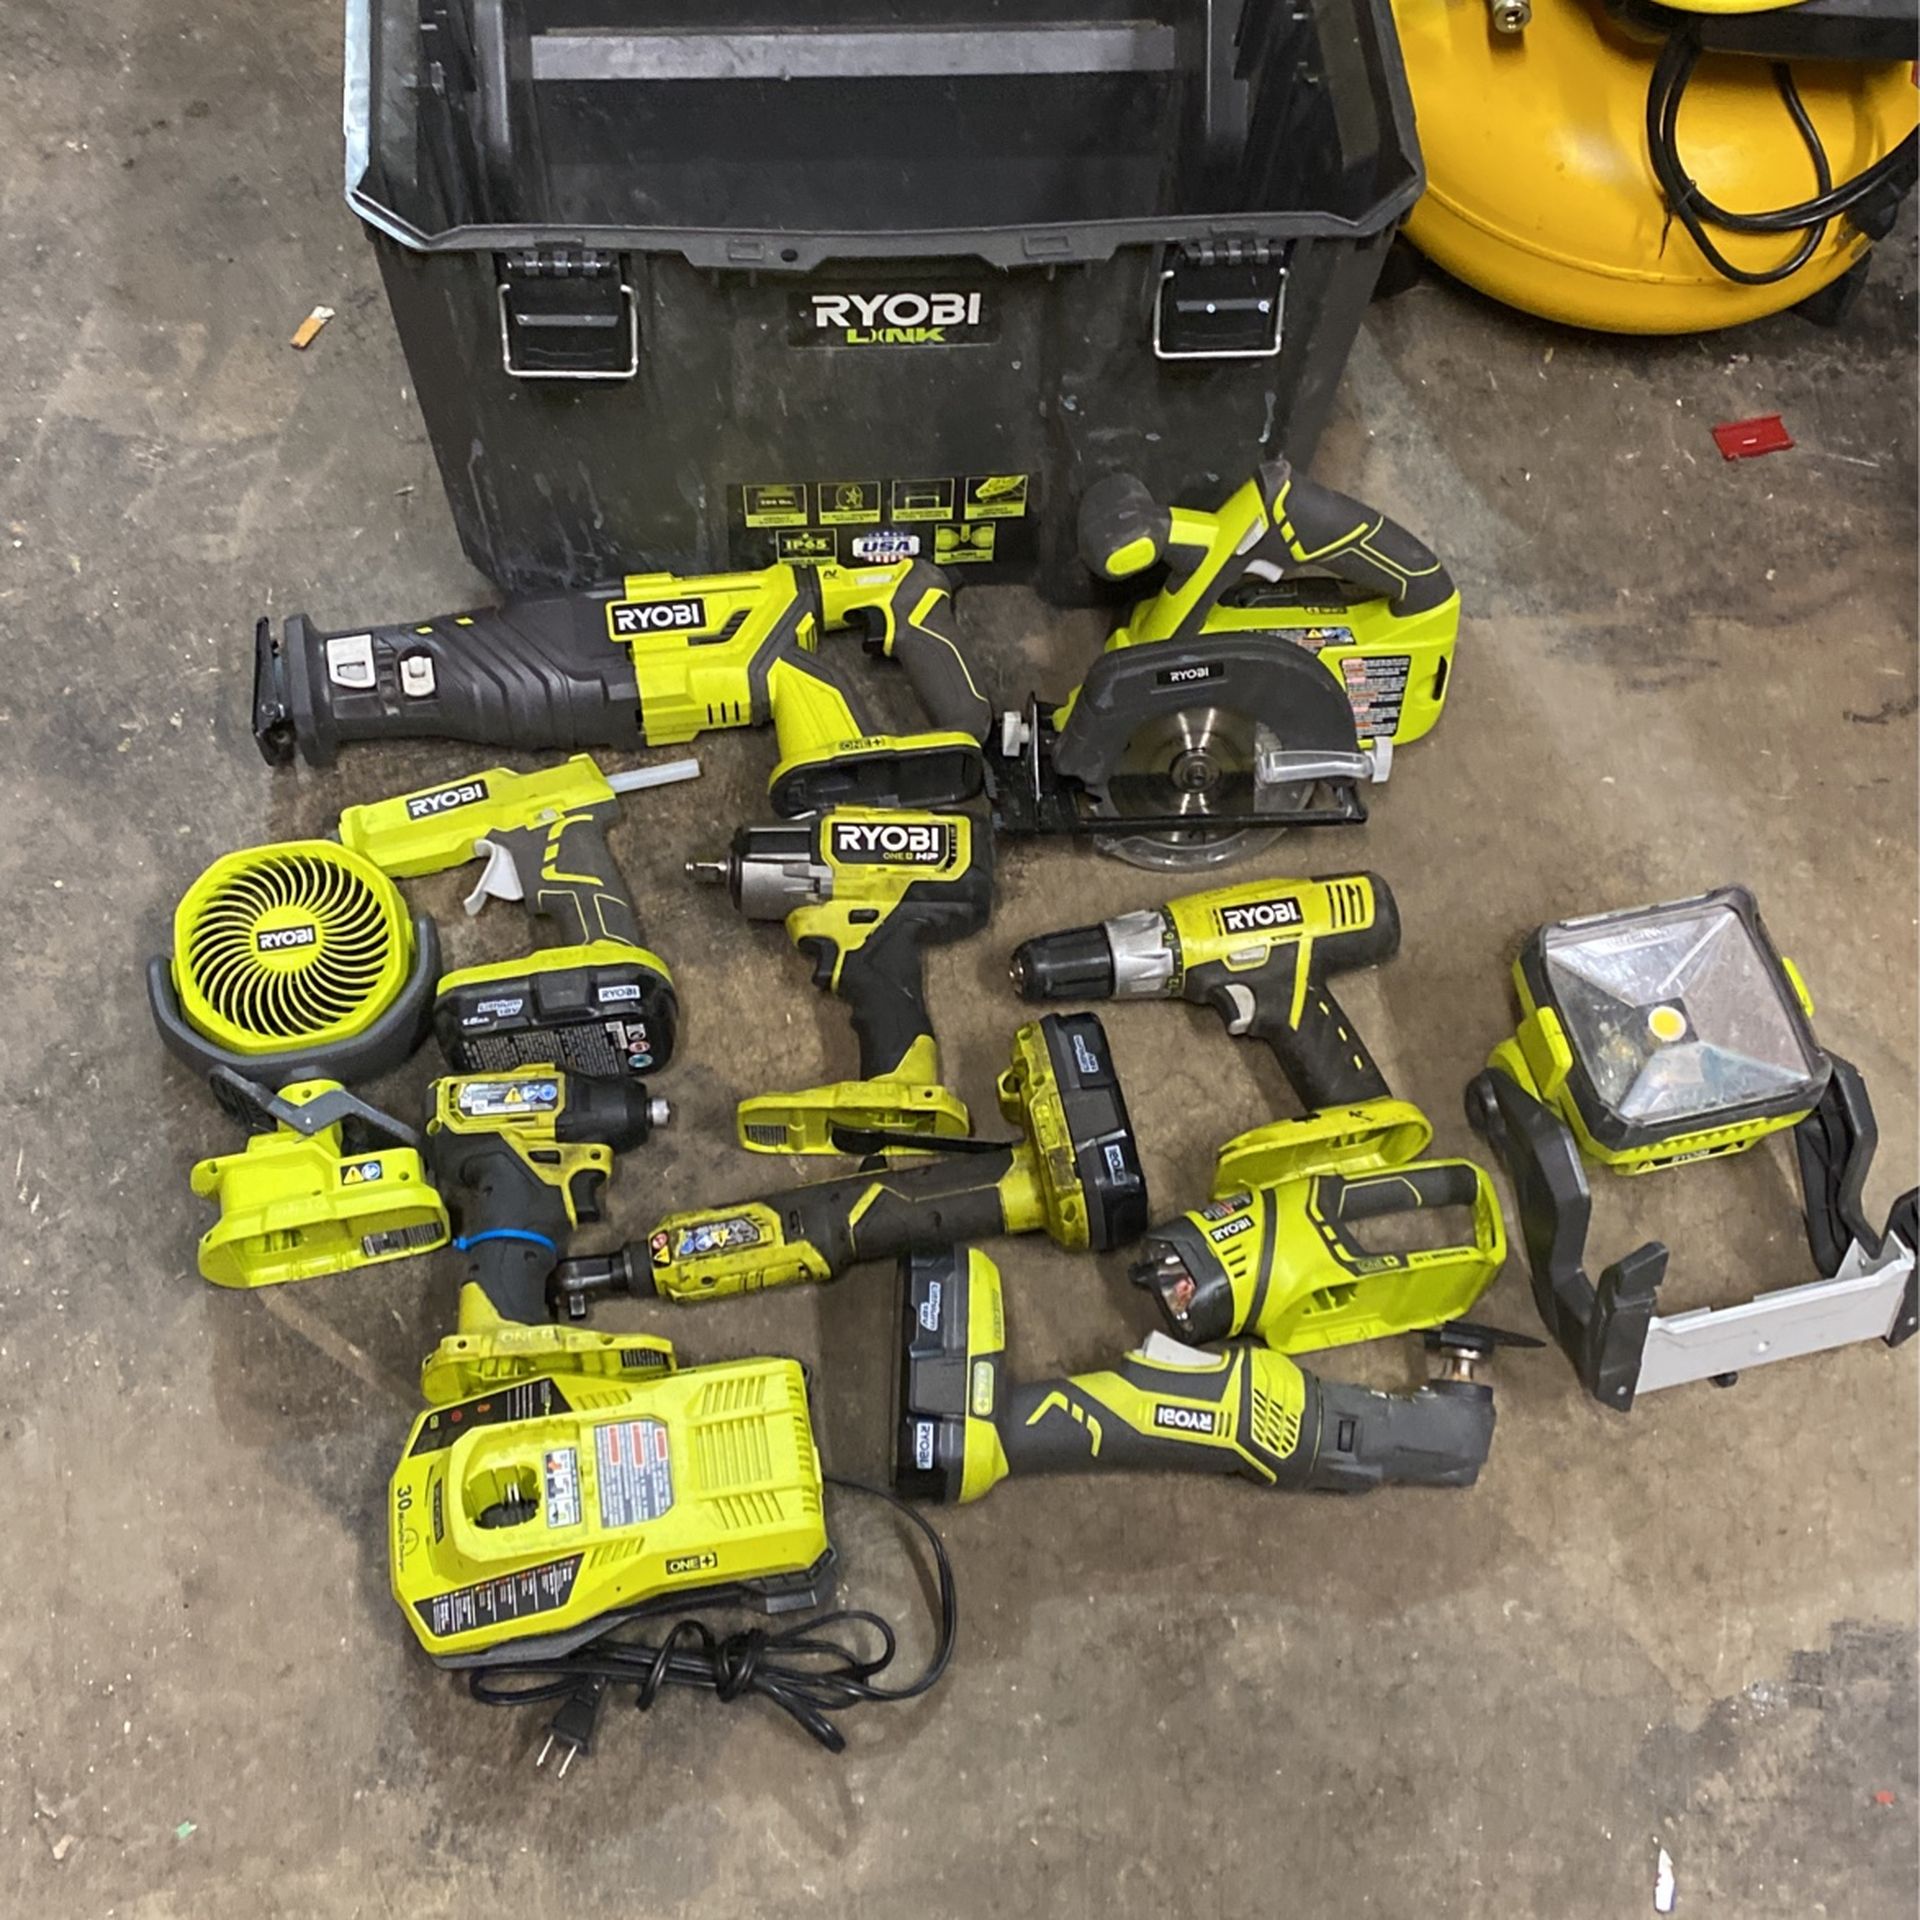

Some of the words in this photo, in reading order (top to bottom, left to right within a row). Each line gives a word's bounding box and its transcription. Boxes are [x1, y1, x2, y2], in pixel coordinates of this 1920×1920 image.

[811, 292, 981, 327] RYOBI
[862, 540, 911, 552] USA
[614, 603, 700, 631] RYOBI
[1170, 666, 1209, 682] RYOBI
[408, 783, 484, 817] RYOBI
[837, 825, 939, 851] RYOBI
[915, 852, 939, 860] HP
[1223, 901, 1299, 930] RYOBI
[258, 927, 314, 949] RYOBI
[601, 987, 639, 998] RYOBI
[1211, 1217, 1251, 1241] RYOBI
[1157, 1406, 1213, 1431] RYOBI
[919, 1424, 931, 1468] RYOBI
[396, 1484, 413, 1511] 30
